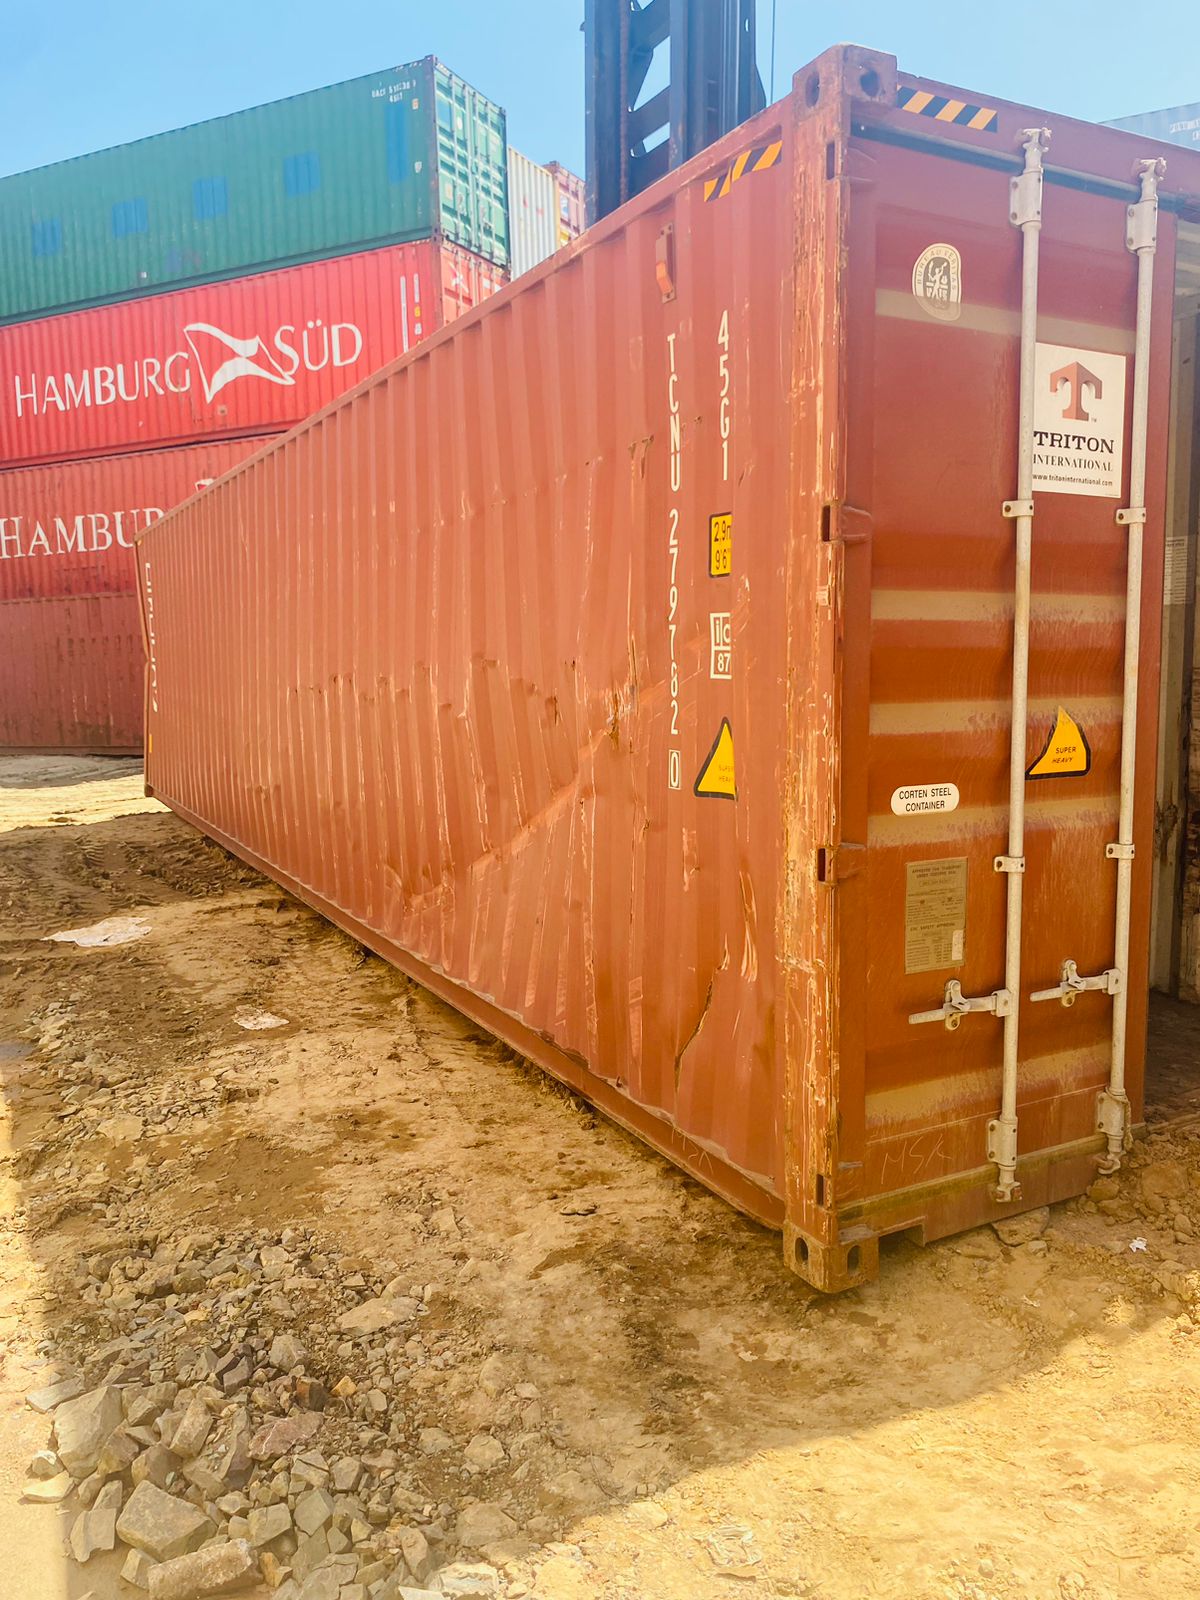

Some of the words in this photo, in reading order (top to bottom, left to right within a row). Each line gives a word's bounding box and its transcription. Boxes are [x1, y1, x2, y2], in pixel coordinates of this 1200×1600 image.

[15, 352, 191, 418] HAMBURG
[274, 319, 363, 376] SÜD
[718, 310, 730, 481] 45G1
[667, 333, 681, 492] TCNU
[1033, 431, 1114, 454] TRITON
[1033, 454, 1113, 472] INTERNATIONAL
[1032, 473, 1113, 487] www.tritoninternational.com
[668, 508, 680, 735] 279782
[1055, 746, 1077, 754] SUPER
[670, 751, 680, 788] 0
[899, 789, 928, 800] CORTEN
[931, 787, 952, 797] STEEL
[905, 800, 945, 812] CONTAINER
